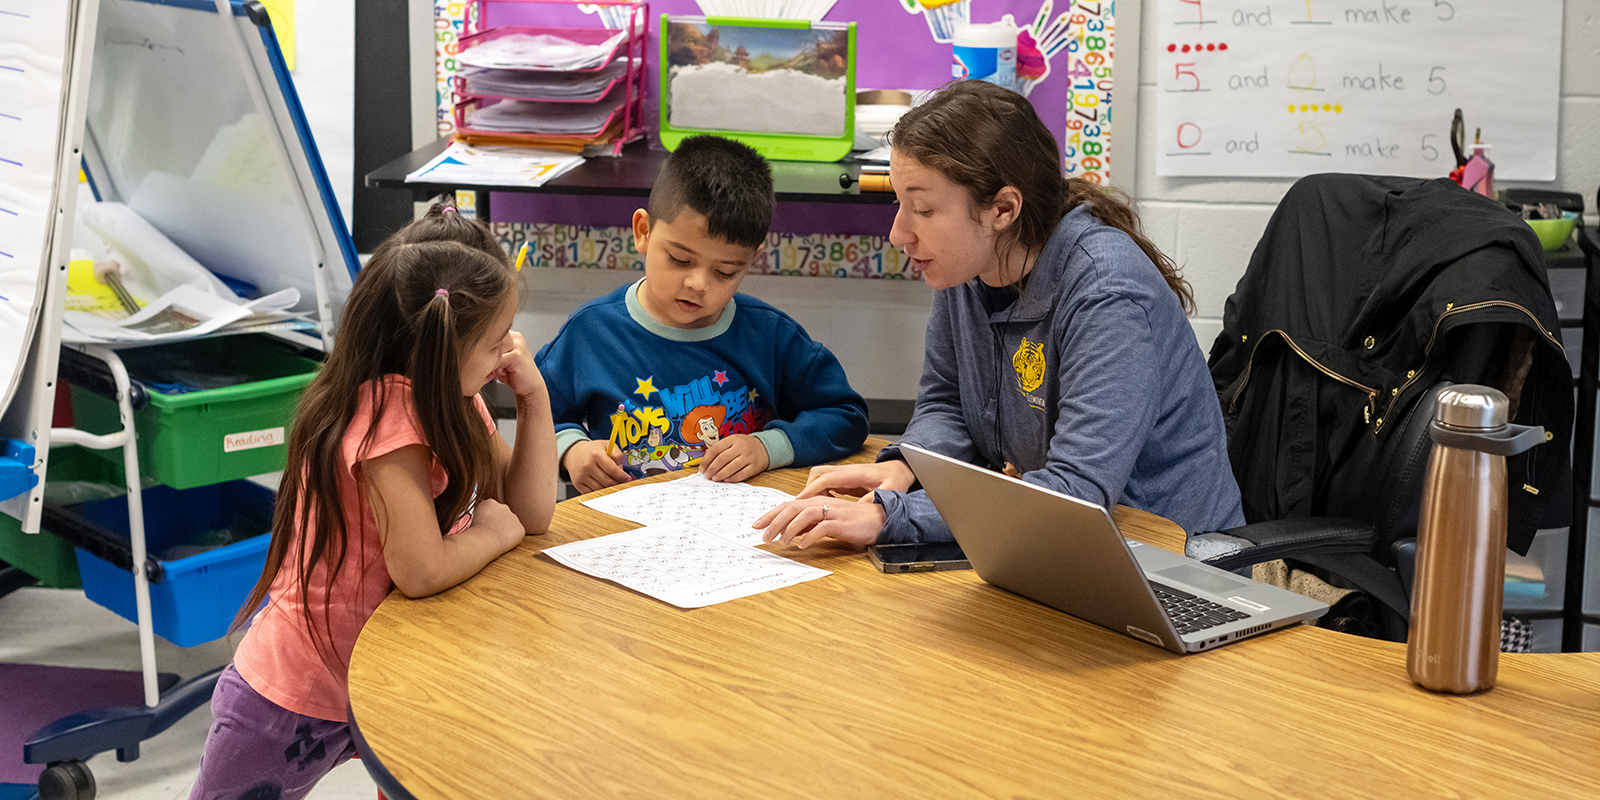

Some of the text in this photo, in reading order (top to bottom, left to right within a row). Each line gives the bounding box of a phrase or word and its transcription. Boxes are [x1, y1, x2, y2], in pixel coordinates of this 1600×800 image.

[1232, 5, 1272, 27] and
[1345, 0, 1411, 24] make
[1175, 63, 1200, 92] 5
[1228, 66, 1268, 90] and
[1343, 62, 1404, 91] make
[1177, 122, 1202, 149] 0
[1225, 131, 1259, 153] and
[1296, 121, 1326, 151] 5
[1345, 137, 1401, 159] make
[720, 385, 747, 421] BE
[226, 433, 273, 449] Reading
[610, 407, 670, 449] TOYS
